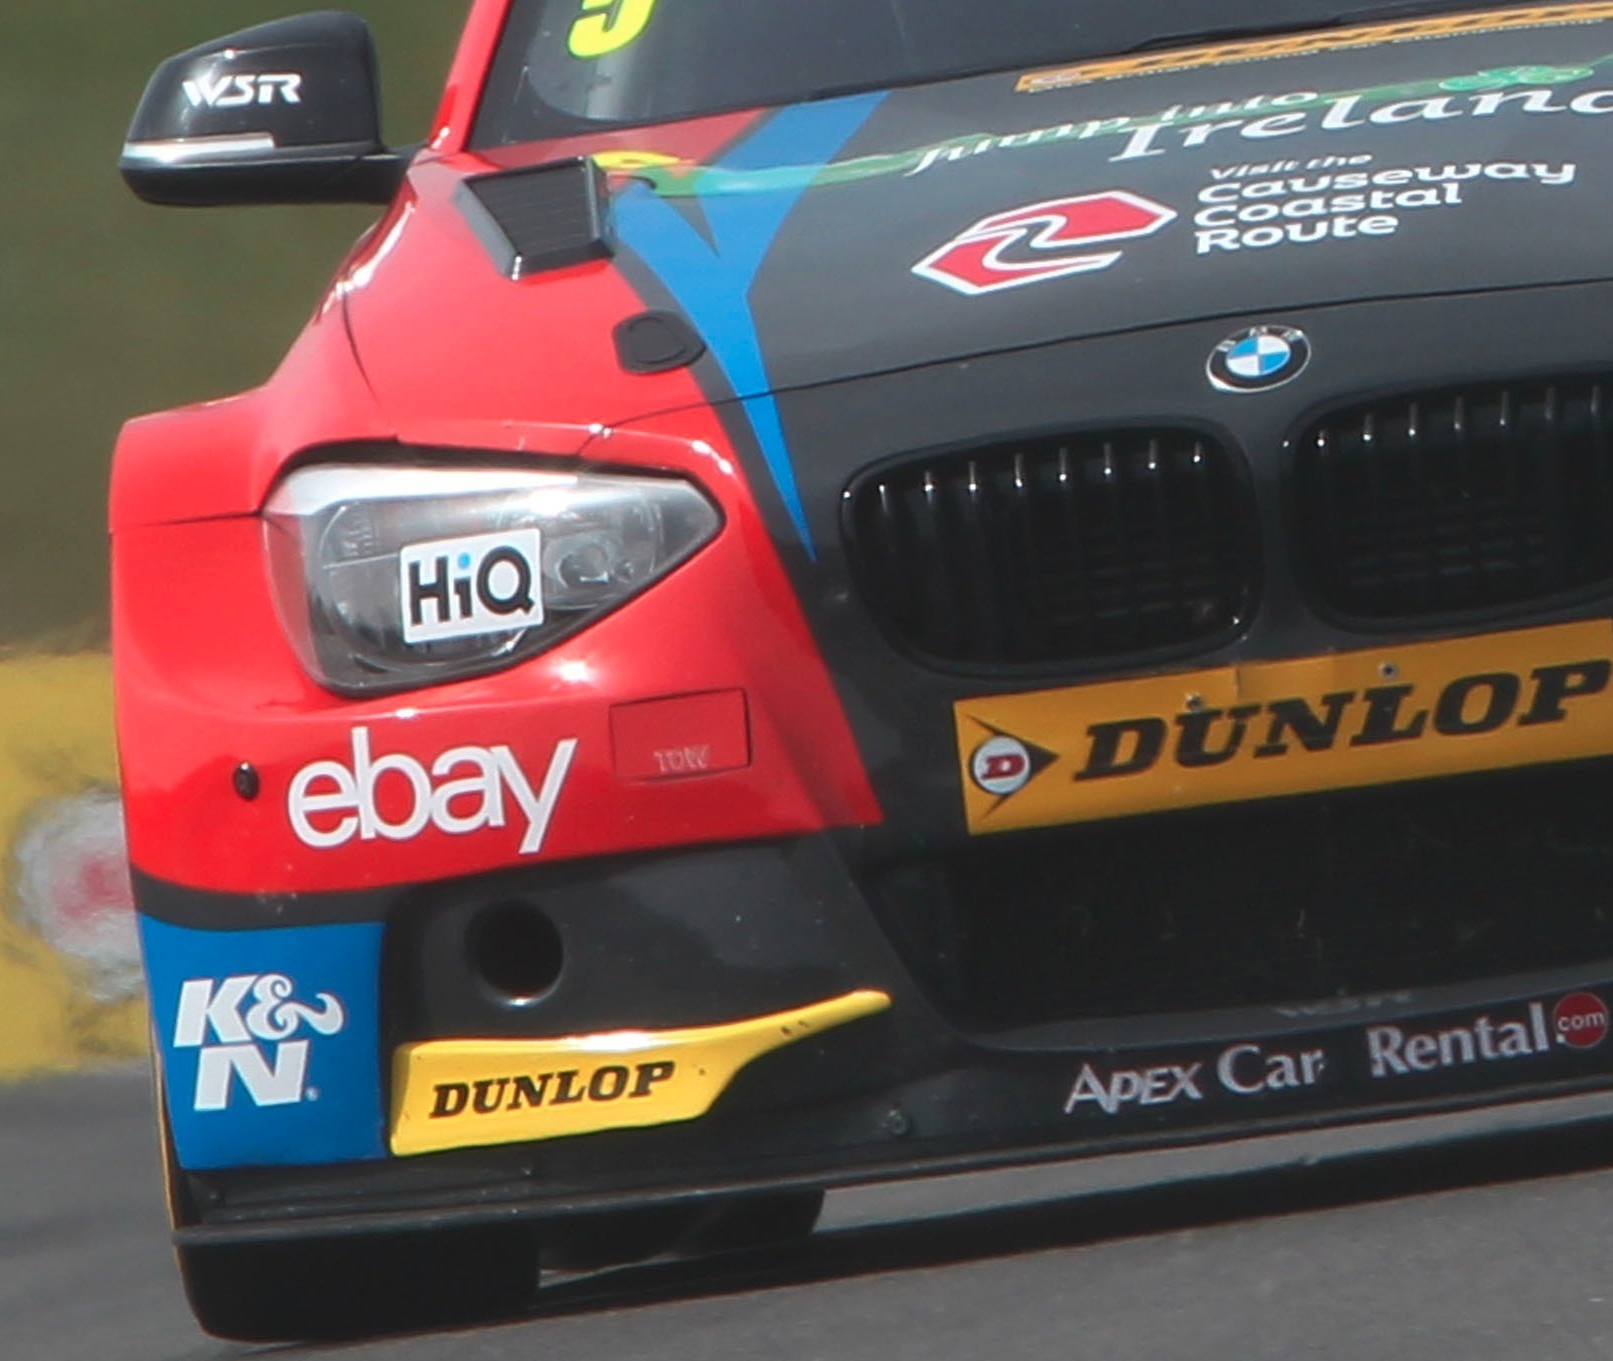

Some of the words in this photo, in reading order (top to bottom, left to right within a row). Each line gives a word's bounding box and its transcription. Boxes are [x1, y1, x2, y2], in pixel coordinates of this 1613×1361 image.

[183, 72, 301, 108] WSR
[1197, 161, 1577, 205] Causeway
[1210, 159, 1293, 181] Visit
[1305, 152, 1374, 170] the
[1193, 183, 1463, 229] Coastal
[1195, 213, 1400, 255] Route
[407, 545, 537, 628] HiQ
[1073, 658, 1612, 782] DUNLOP
[653, 745, 710, 773] TOW
[287, 726, 577, 854] ebay
[430, 1061, 675, 1118] DUNLOP
[1217, 1044, 1326, 1095] Car
